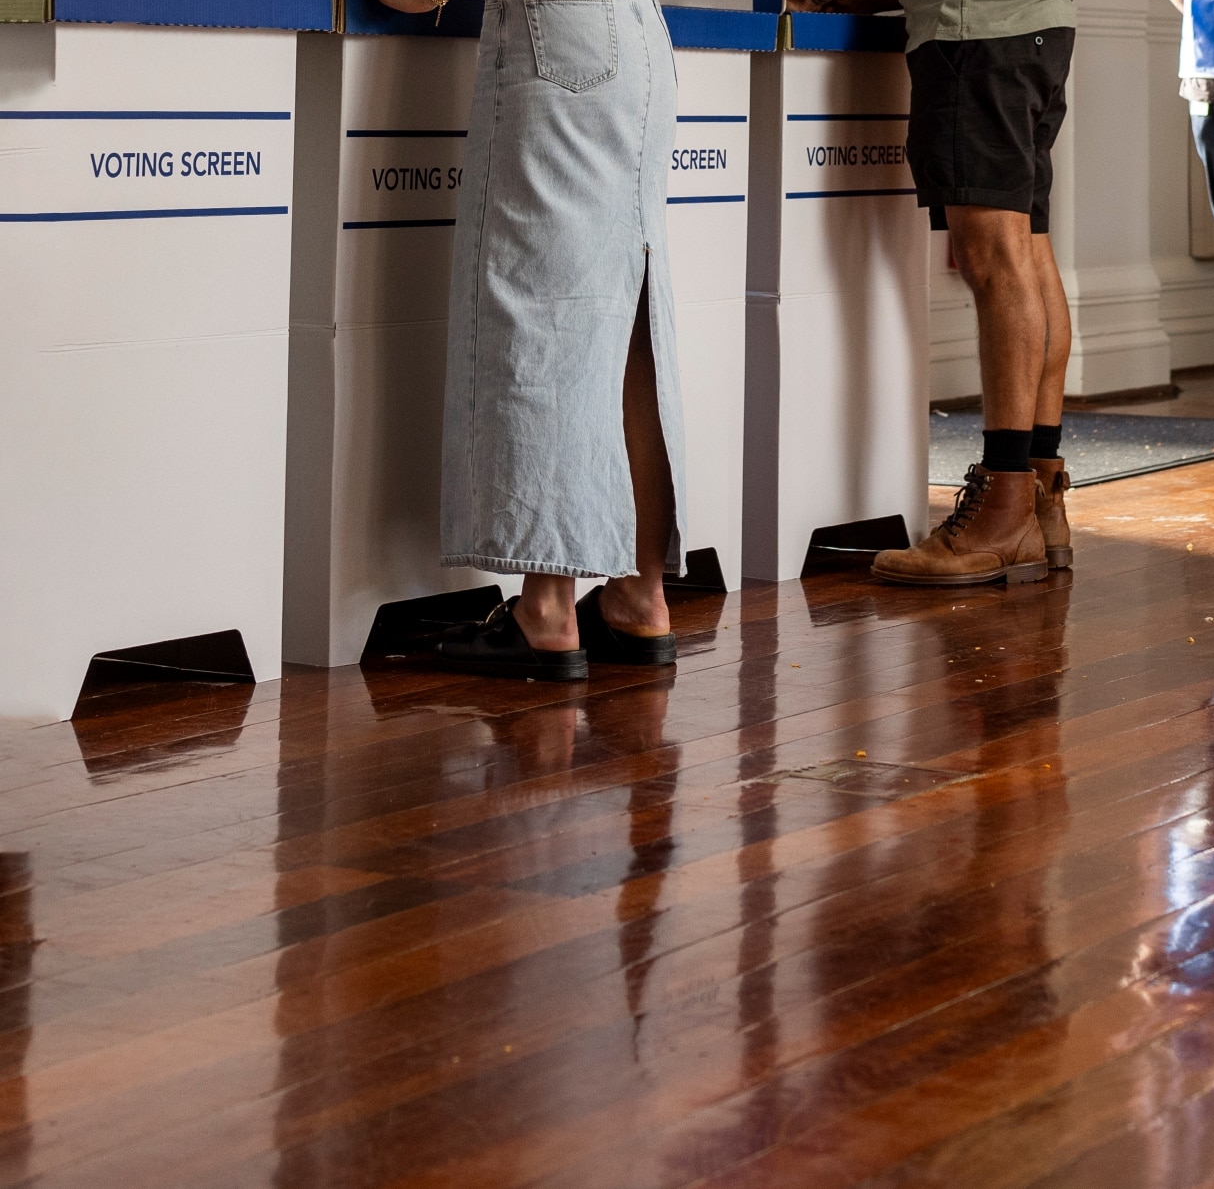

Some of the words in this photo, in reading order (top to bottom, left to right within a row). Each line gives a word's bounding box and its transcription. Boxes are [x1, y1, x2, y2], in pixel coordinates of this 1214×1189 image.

[91, 151, 174, 178] VOTING
[181, 151, 261, 176] SCREEN
[671, 149, 727, 170] SCREEN
[806, 145, 857, 167] VOTING
[372, 167, 442, 191] VOTING
